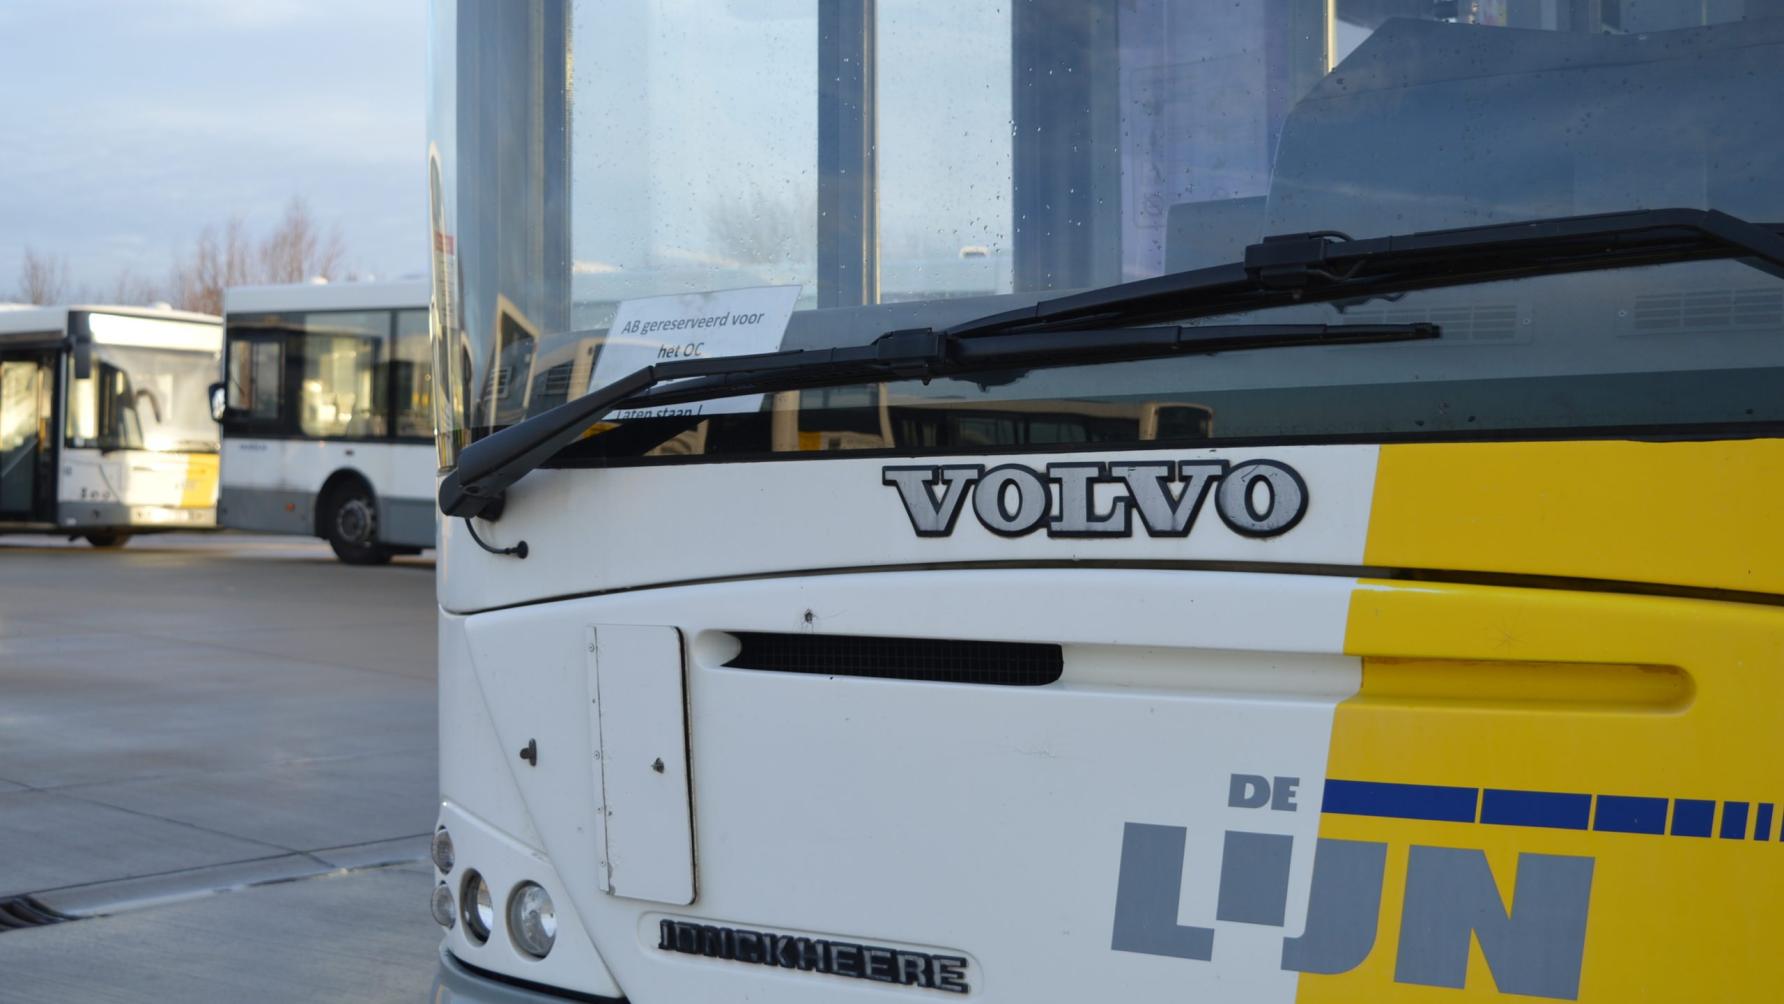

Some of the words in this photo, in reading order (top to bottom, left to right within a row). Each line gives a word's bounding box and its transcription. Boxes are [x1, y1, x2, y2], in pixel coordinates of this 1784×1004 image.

[621, 320, 641, 335] AB
[640, 312, 730, 336] gereserveerd
[731, 312, 766, 326] voor
[657, 344, 681, 359] het
[683, 342, 705, 357] OC
[882, 458, 1309, 539] VOLVO
[1227, 773, 1300, 811] DE
[658, 918, 969, 994] JONCKHEERE
